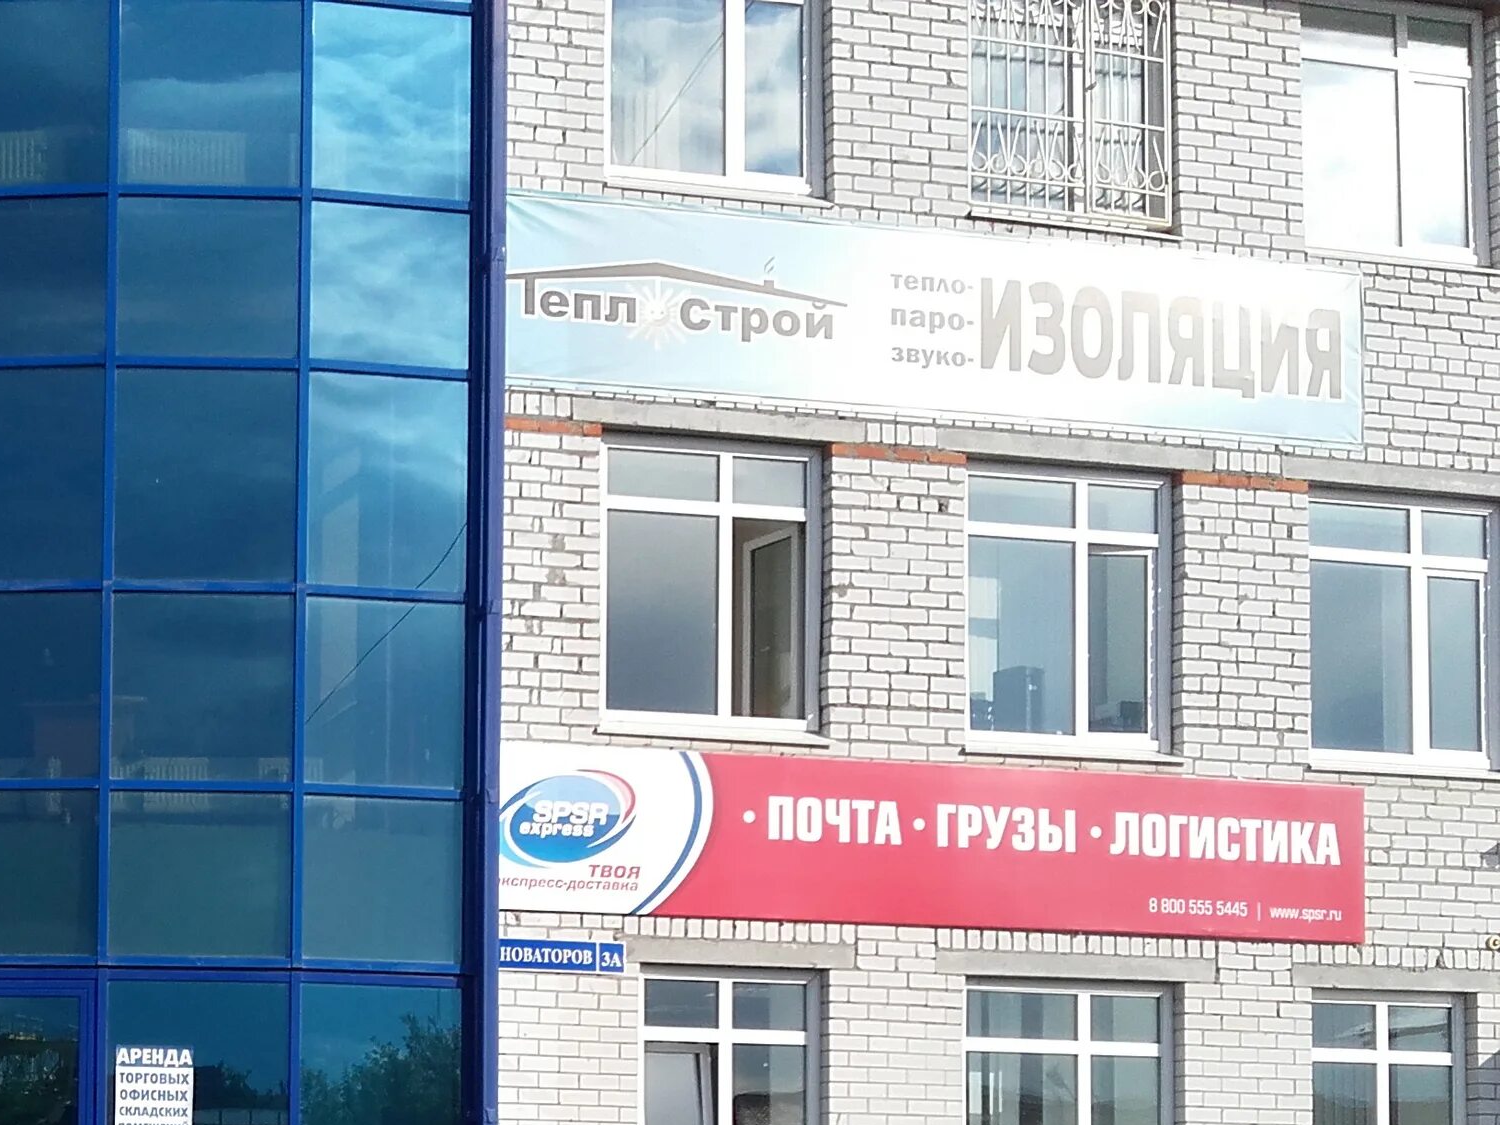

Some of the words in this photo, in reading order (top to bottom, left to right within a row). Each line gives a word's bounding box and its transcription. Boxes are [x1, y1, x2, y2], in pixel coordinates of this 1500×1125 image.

[891, 273, 974, 295] тепло-
[891, 307, 974, 333] паро-
[980, 277, 1342, 400] ИЗОЛЯЦИЯ
[891, 345, 974, 368] звуко-
[533, 801, 609, 825] SPSR
[519, 822, 594, 838] express
[768, 795, 902, 845] ПОЧТА
[936, 803, 1077, 853] ГРУЗЫ
[1110, 811, 1341, 866] ЛОГИСТИКА
[588, 865, 641, 879] ТВОЯ
[499, 876, 638, 892] кспресс-доставка
[1149, 898, 1157, 913] 8
[1161, 898, 1185, 914] 800
[1188, 900, 1213, 916] 555
[1216, 901, 1248, 917] 5445
[1269, 906, 1342, 923] www.spsr.ru
[499, 946, 593, 964] НОВАТОРОВ
[116, 1048, 193, 1067] АРЕНДА
[119, 1072, 189, 1085] ТОРГОВЫХ
[120, 1089, 188, 1101] ОФИСНЫХ
[119, 1106, 188, 1117] СКЛАДСКИХ
